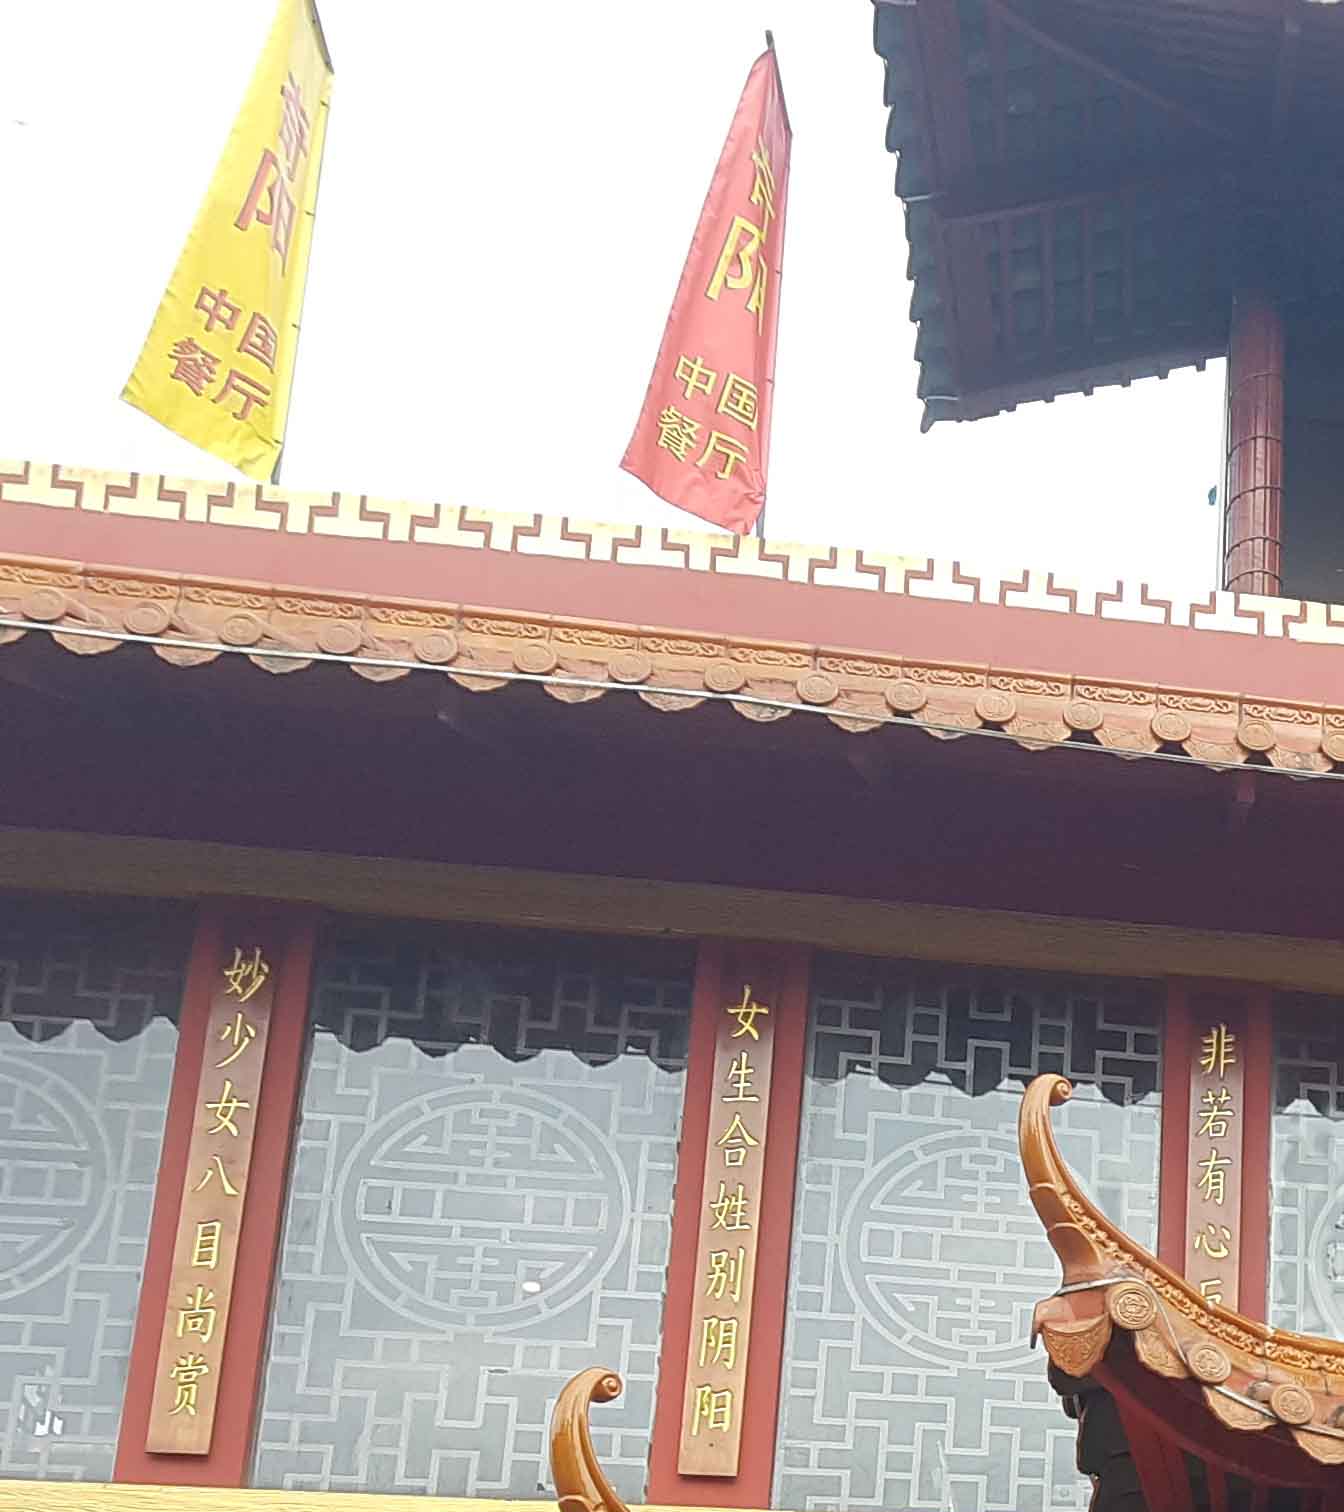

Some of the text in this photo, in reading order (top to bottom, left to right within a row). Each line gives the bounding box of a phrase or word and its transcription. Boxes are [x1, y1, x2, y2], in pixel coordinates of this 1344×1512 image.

[194, 285, 279, 375] 中国
[167, 336, 272, 422] 餐厅
[673, 355, 759, 433] 中国
[655, 404, 751, 481] 餐厅
[168, 944, 271, 1419] 妙少女八目尚赏
[689, 984, 771, 1439] 女生合姓别阴阳
